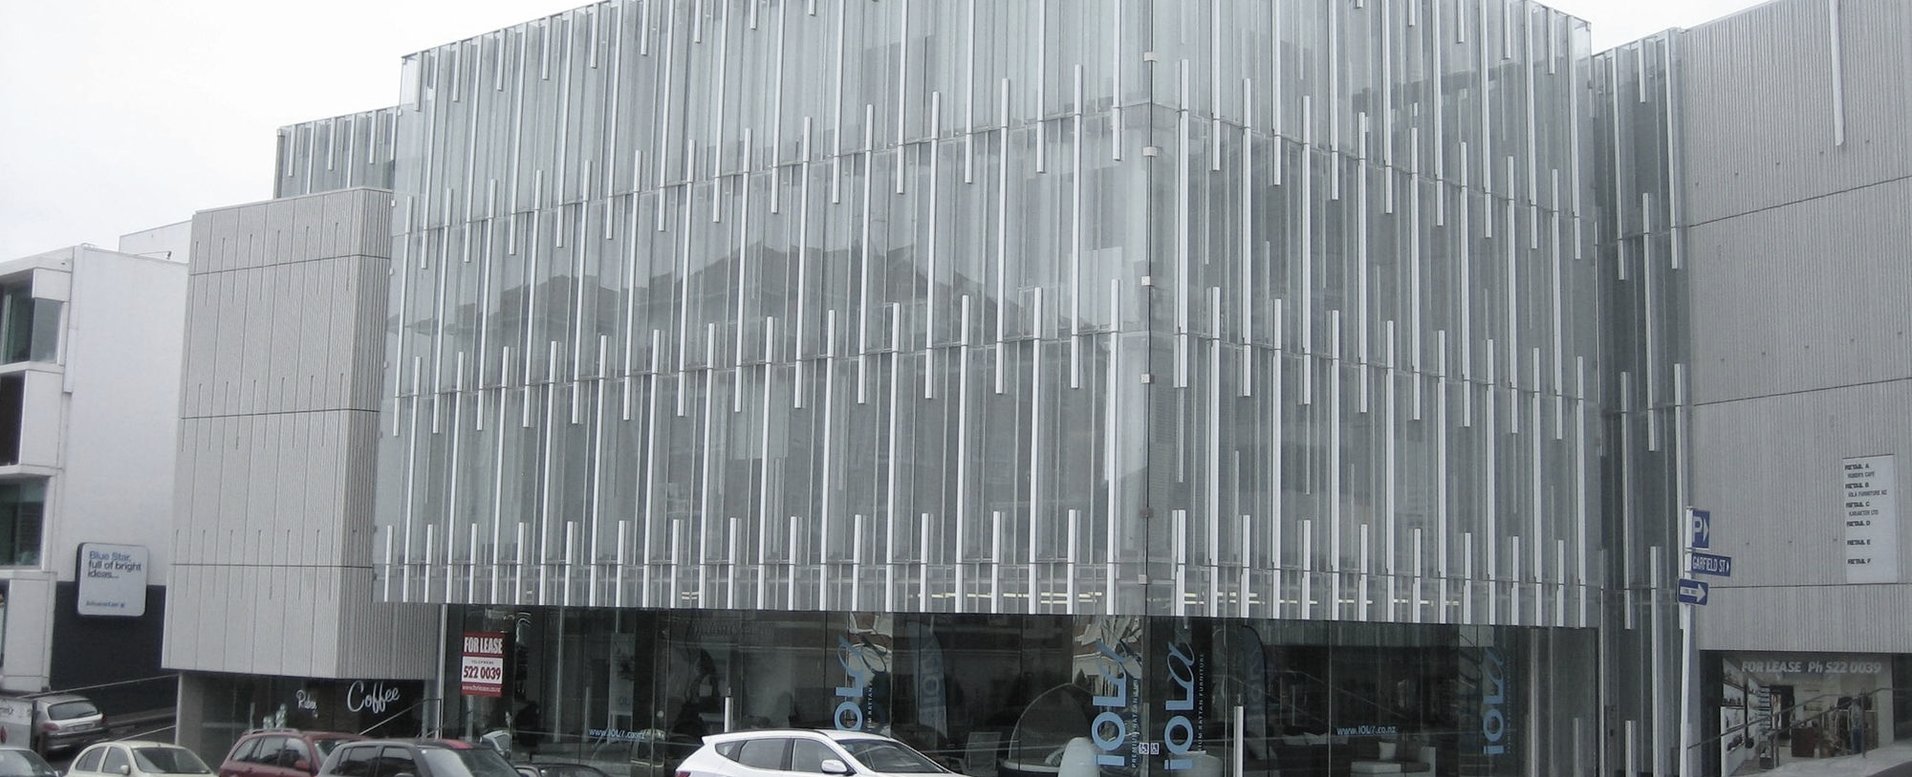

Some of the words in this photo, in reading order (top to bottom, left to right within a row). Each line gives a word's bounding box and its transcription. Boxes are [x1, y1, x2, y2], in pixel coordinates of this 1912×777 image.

[1692, 516, 1703, 543] P
[90, 551, 110, 560] Blue
[89, 560, 102, 569] full
[104, 560, 114, 570] of
[115, 561, 142, 573] bright
[1692, 556, 1718, 572] GARFIELD
[1719, 559, 1726, 573] ST
[464, 637, 480, 653] FOR
[480, 638, 503, 654] LEASE
[463, 665, 479, 678] 522
[480, 666, 502, 680] 0039
[1741, 661, 1765, 672] FOR
[1766, 661, 1802, 673] LEASE
[1807, 661, 1823, 673] Ph
[1825, 661, 1847, 673] 522
[1849, 662, 1882, 674] 0039
[347, 680, 401, 714] Coffee
